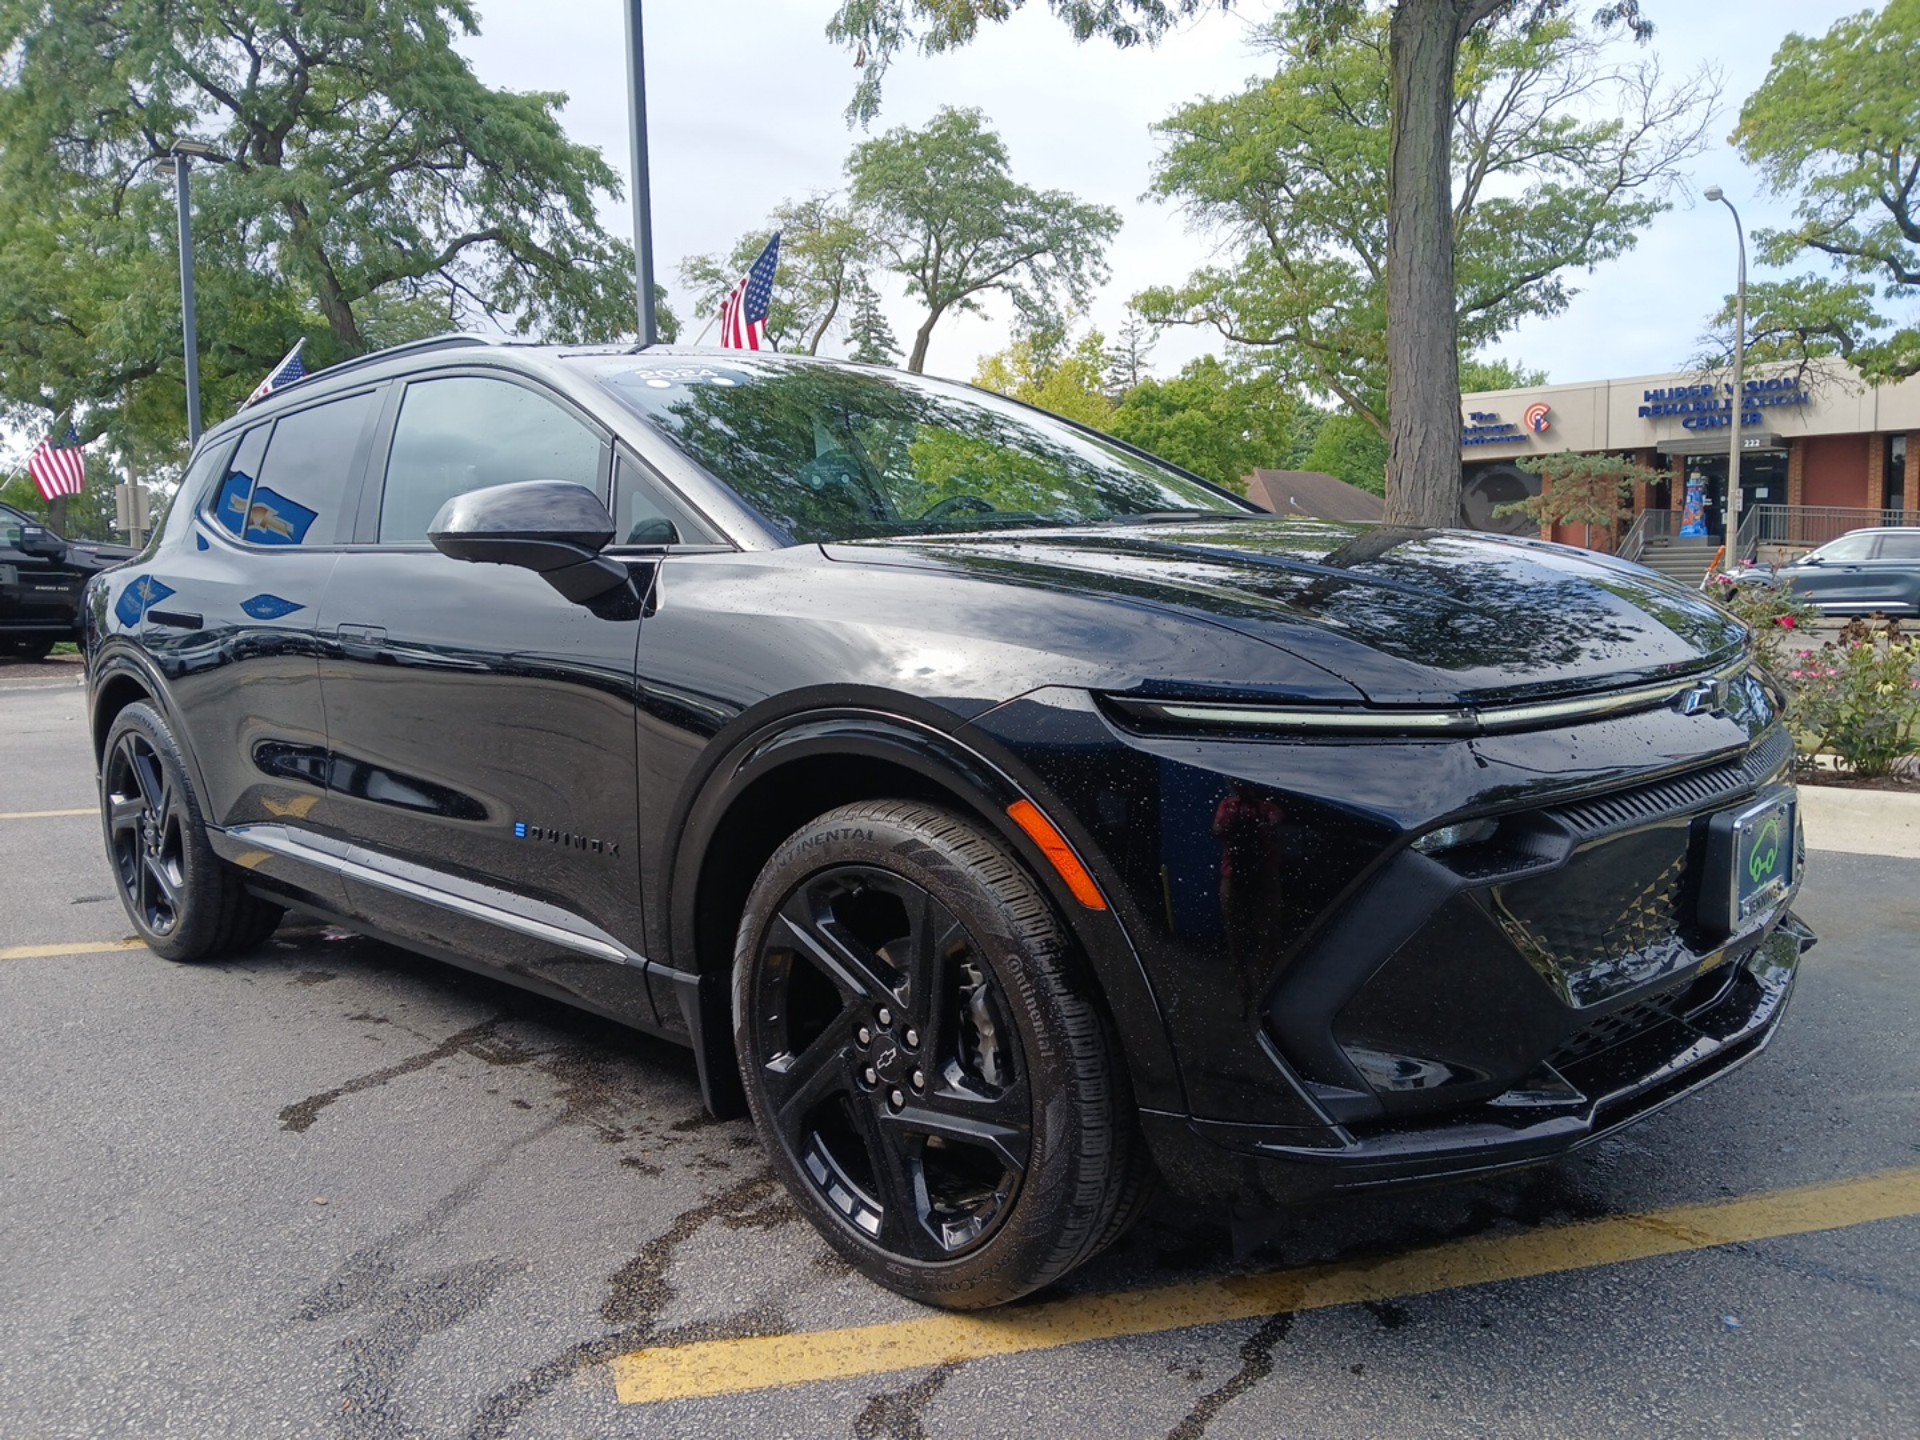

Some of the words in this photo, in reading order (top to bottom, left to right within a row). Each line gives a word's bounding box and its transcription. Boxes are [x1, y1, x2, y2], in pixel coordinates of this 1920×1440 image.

[1638, 391, 1809, 418] REHABILIATION
[1644, 384, 1714, 402] HUBER
[1682, 411, 1763, 430] CENTER
[1743, 439, 1760, 448] 222
[514, 821, 620, 859] EQUINOX
[771, 827, 876, 876] NTINENTAL
[1006, 954, 1055, 1057] Continental
